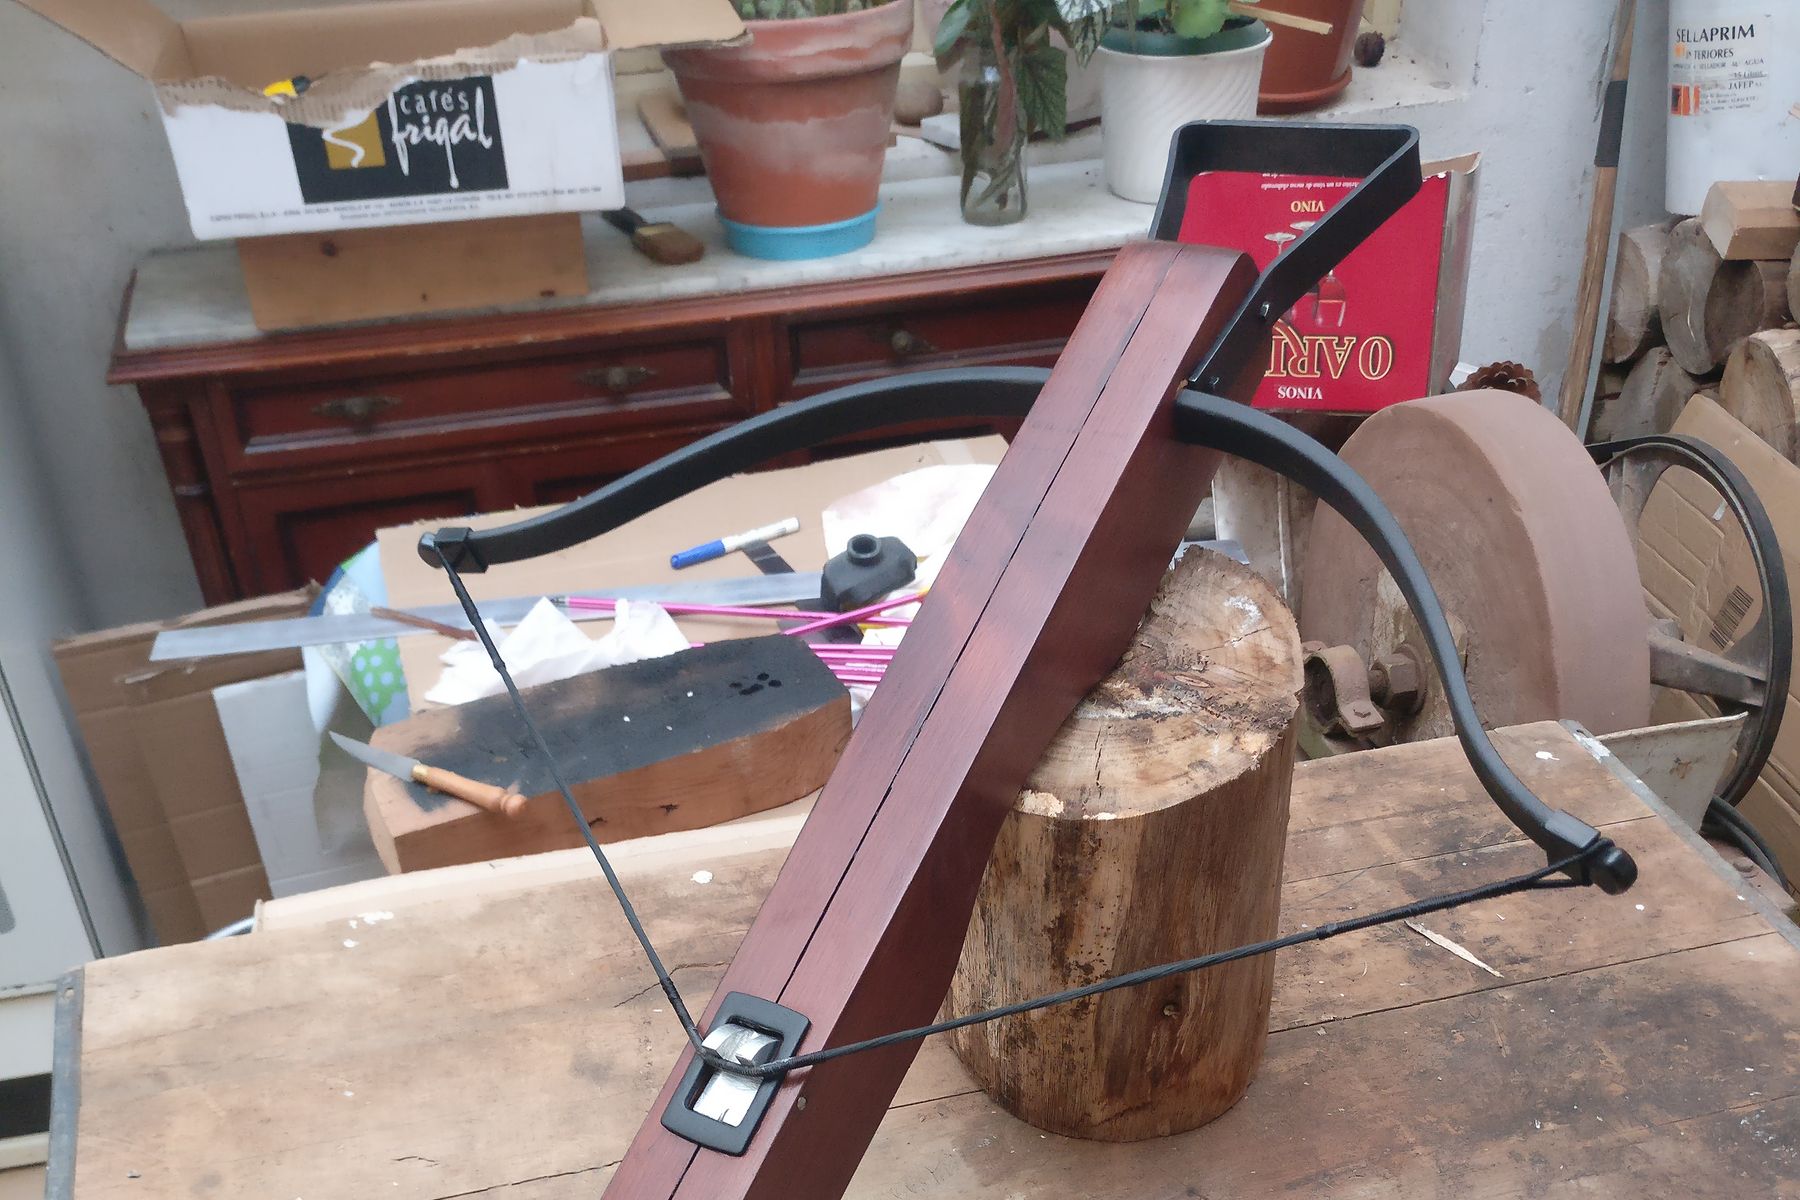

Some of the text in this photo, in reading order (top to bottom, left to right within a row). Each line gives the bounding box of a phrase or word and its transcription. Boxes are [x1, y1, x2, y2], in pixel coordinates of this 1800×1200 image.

[1676, 23, 1755, 43] SELLAPRIM
[1685, 48, 1734, 60] NTERIORES
[400, 86, 470, 115] cafés
[1290, 200, 1325, 212] VINO
[1358, 336, 1393, 381] O
[1277, 385, 1323, 400] VINOS
